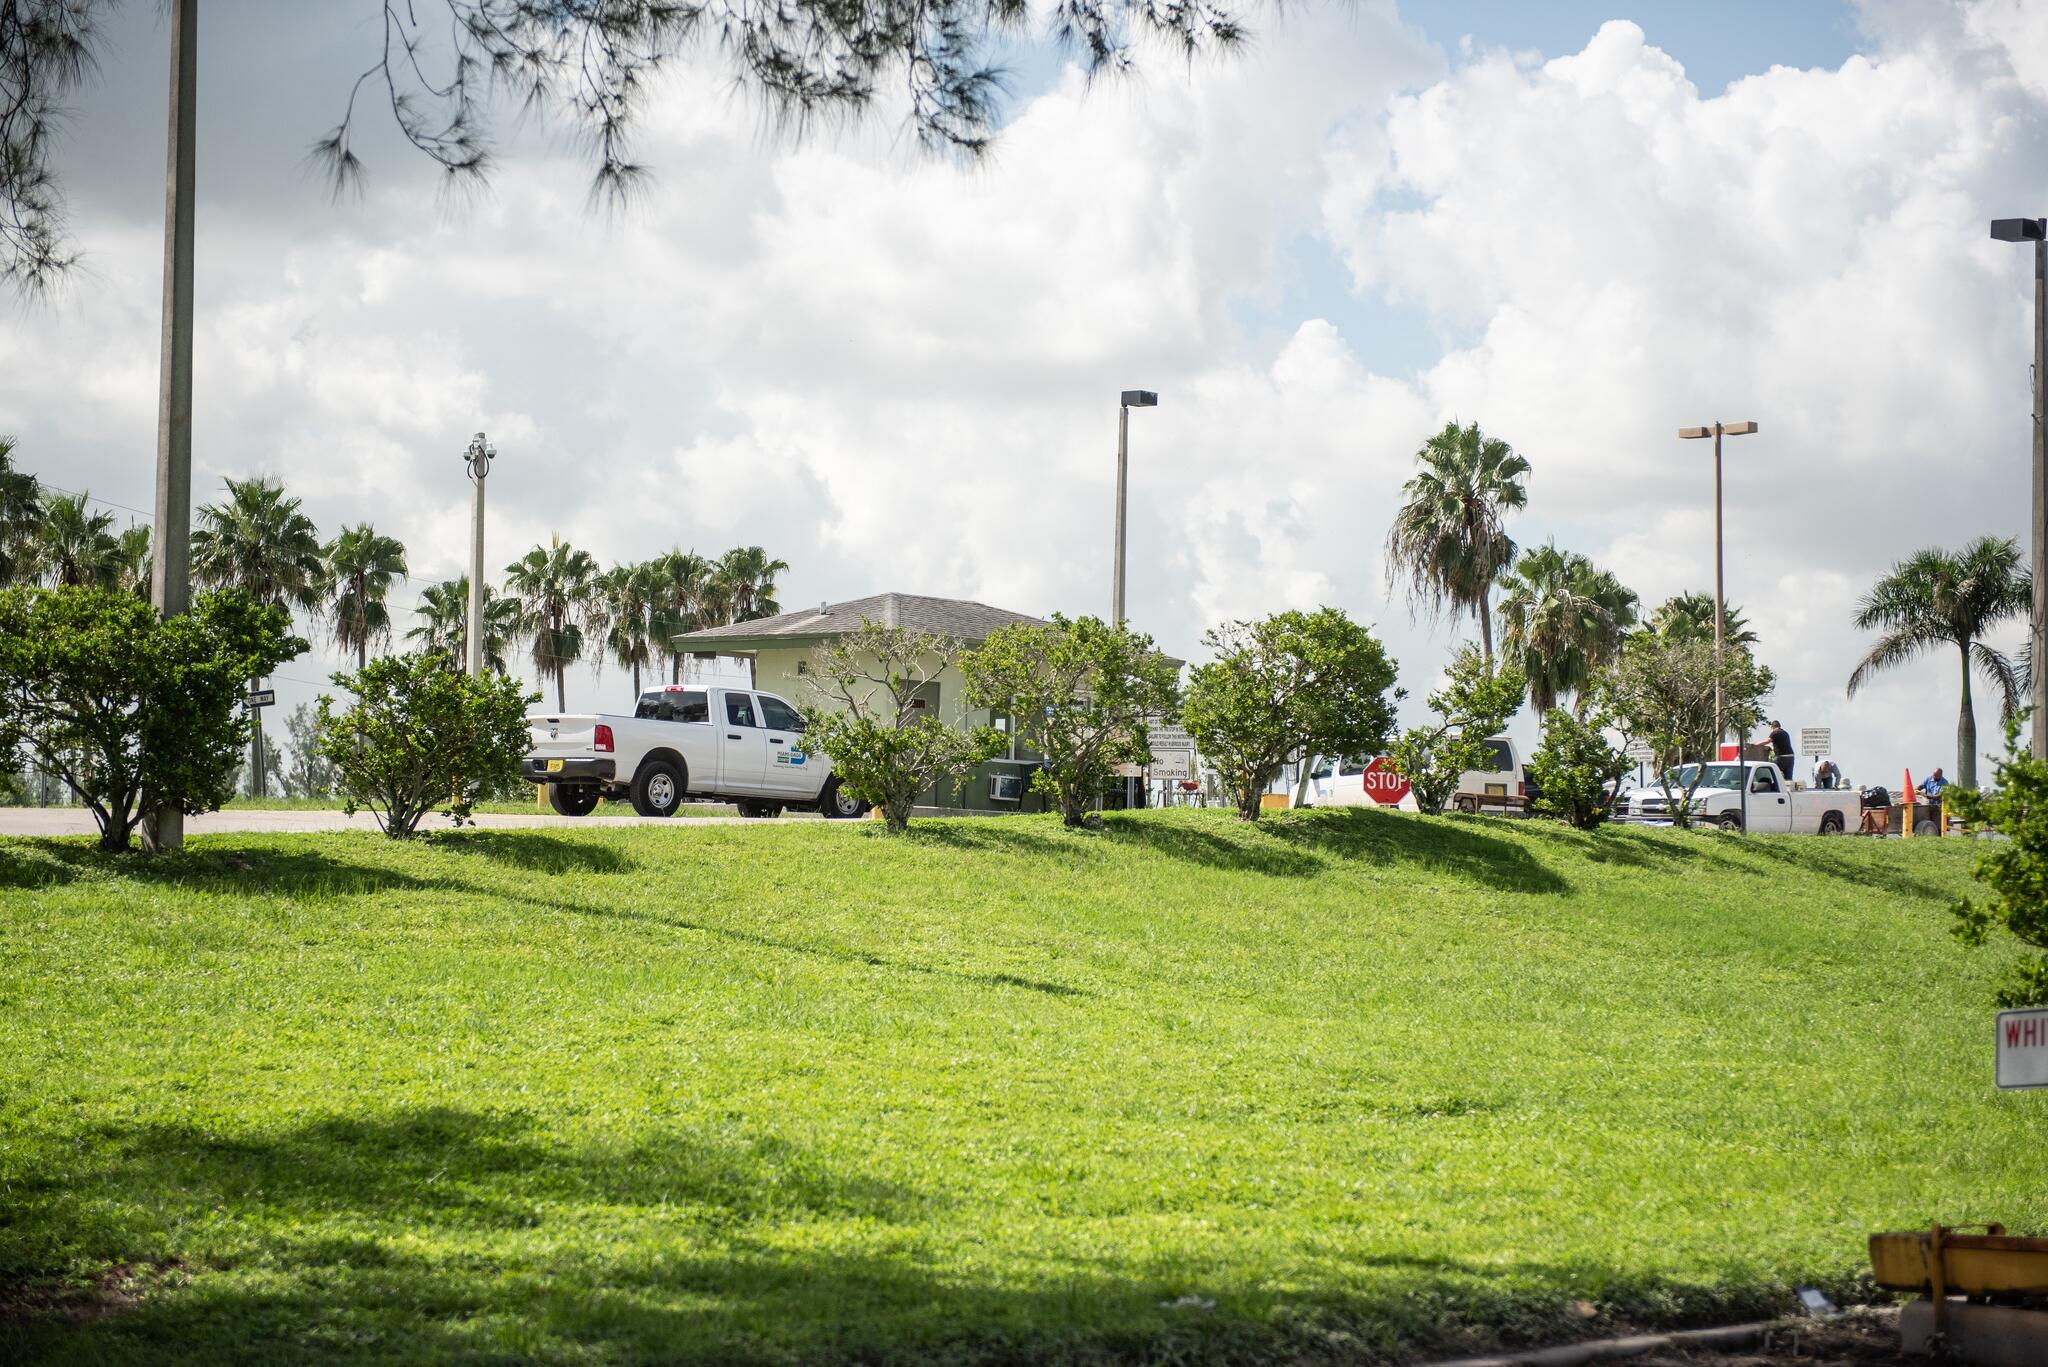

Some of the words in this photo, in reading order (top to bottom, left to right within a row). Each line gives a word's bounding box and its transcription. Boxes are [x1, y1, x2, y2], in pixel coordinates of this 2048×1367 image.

[248, 696, 257, 704] ONE
[1153, 768, 1188, 778] Smoking
[1366, 771, 1408, 790] STOP
[2005, 1018, 2048, 1049] WHI
